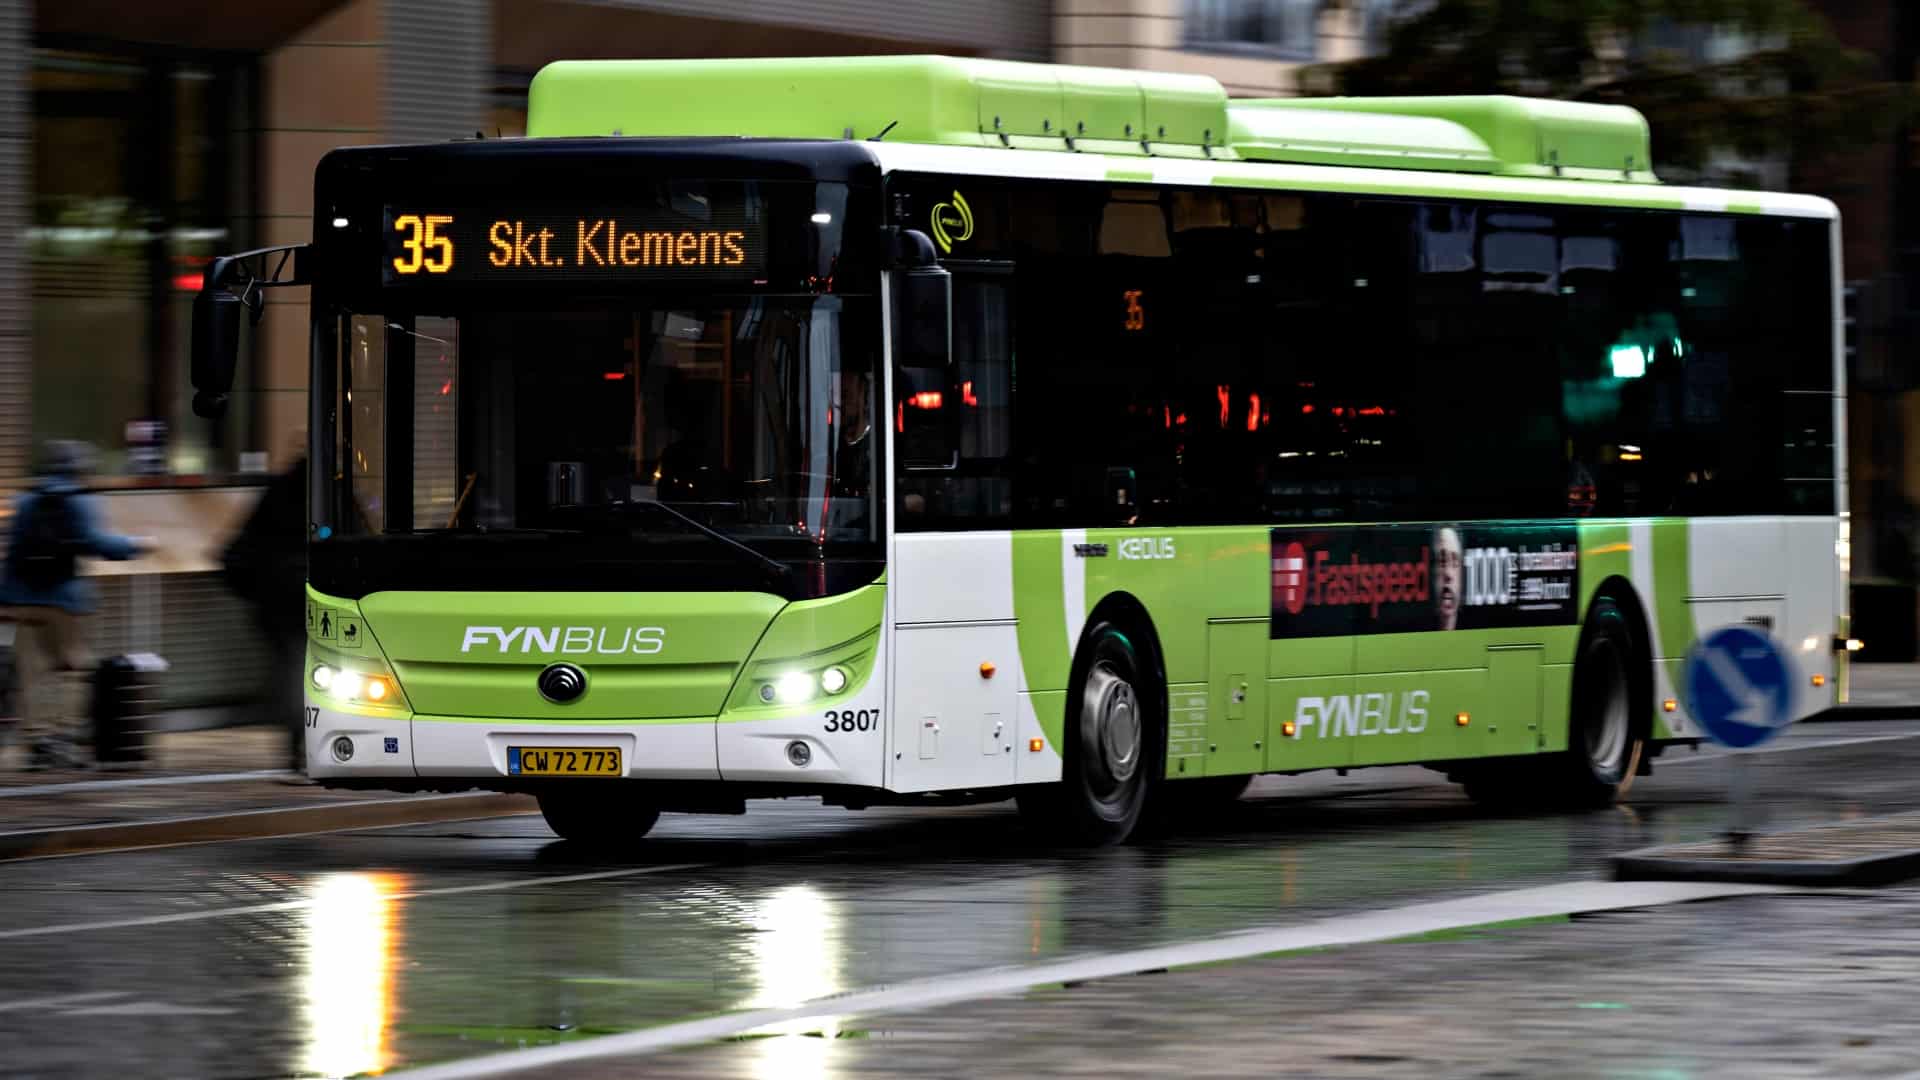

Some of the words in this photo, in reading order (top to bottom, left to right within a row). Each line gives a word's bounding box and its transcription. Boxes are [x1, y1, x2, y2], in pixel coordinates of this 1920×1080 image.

[394, 216, 453, 273] 35
[489, 220, 564, 266] Skt.
[578, 220, 745, 265] Klemens
[1123, 290, 1145, 330] 35
[1313, 545, 1430, 619] Fastspeed
[460, 626, 665, 655] FYNBUS
[305, 706, 321, 729] 07
[823, 708, 881, 733] 3807
[1294, 690, 1431, 740] FYNBUS
[522, 751, 548, 771] CW
[553, 751, 577, 771] 72
[582, 751, 618, 771] 773
